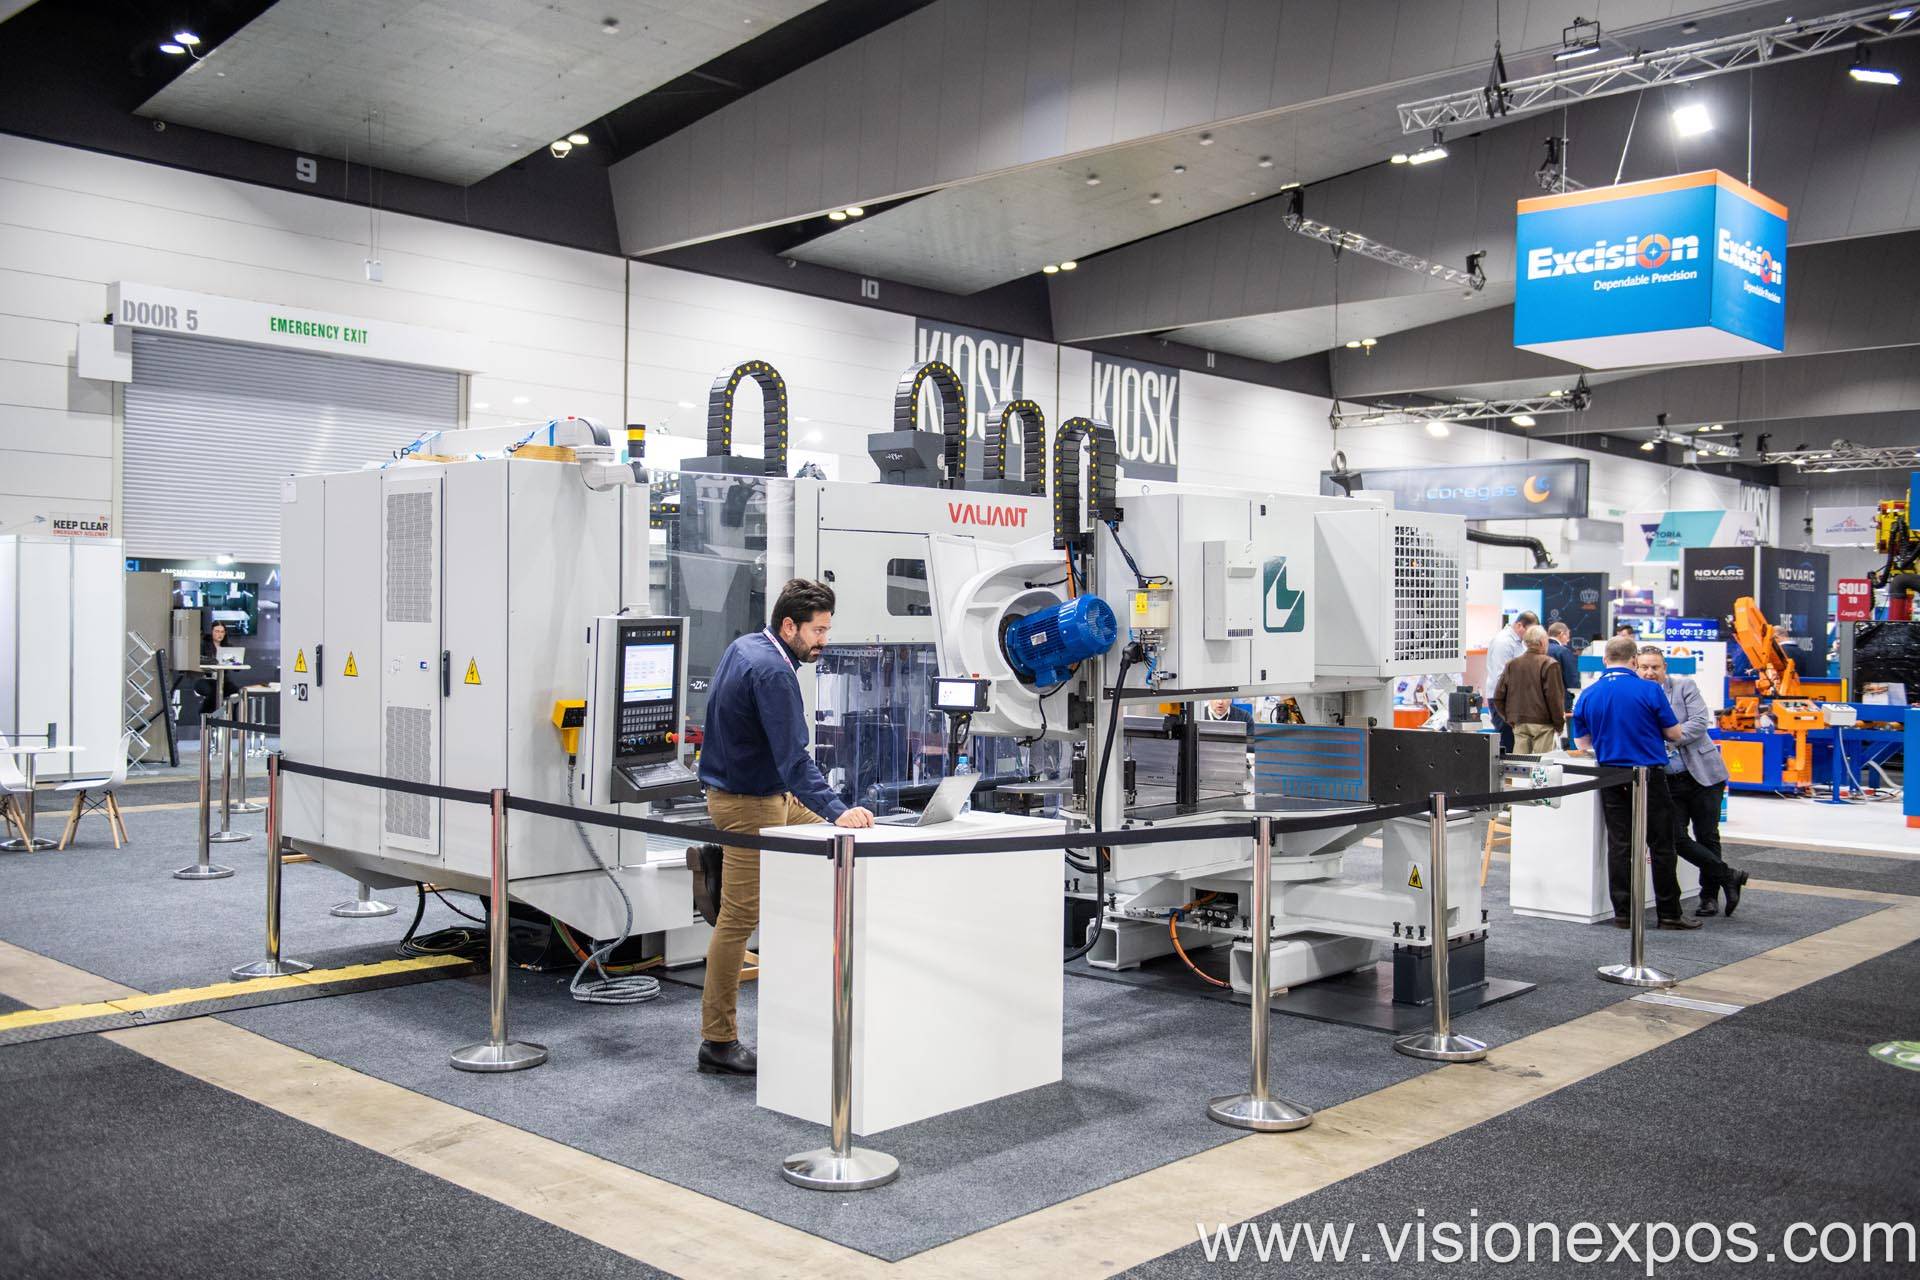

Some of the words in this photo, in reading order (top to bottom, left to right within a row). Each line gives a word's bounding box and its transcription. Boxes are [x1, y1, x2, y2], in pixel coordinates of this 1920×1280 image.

[296, 156, 317, 184] 9
[1527, 233, 1699, 280] Excision
[1718, 227, 1782, 285] Excision
[1593, 274, 1649, 292] Dependable
[1651, 269, 1697, 284] Precision
[123, 299, 177, 328] DOOR
[186, 309, 198, 331] 5
[270, 317, 339, 339] EMERGENCY
[343, 328, 368, 344] EXIT
[1094, 361, 1178, 465] KIOSK
[1426, 485, 1518, 501] coregas
[53, 519, 78, 529] KEEP
[80, 521, 109, 531] CLEAR
[948, 502, 1028, 527] VALIANT
[1694, 569, 1744, 577] NOVARC
[1778, 567, 1815, 582] NOVARC
[1838, 583, 1868, 595] SOLD
